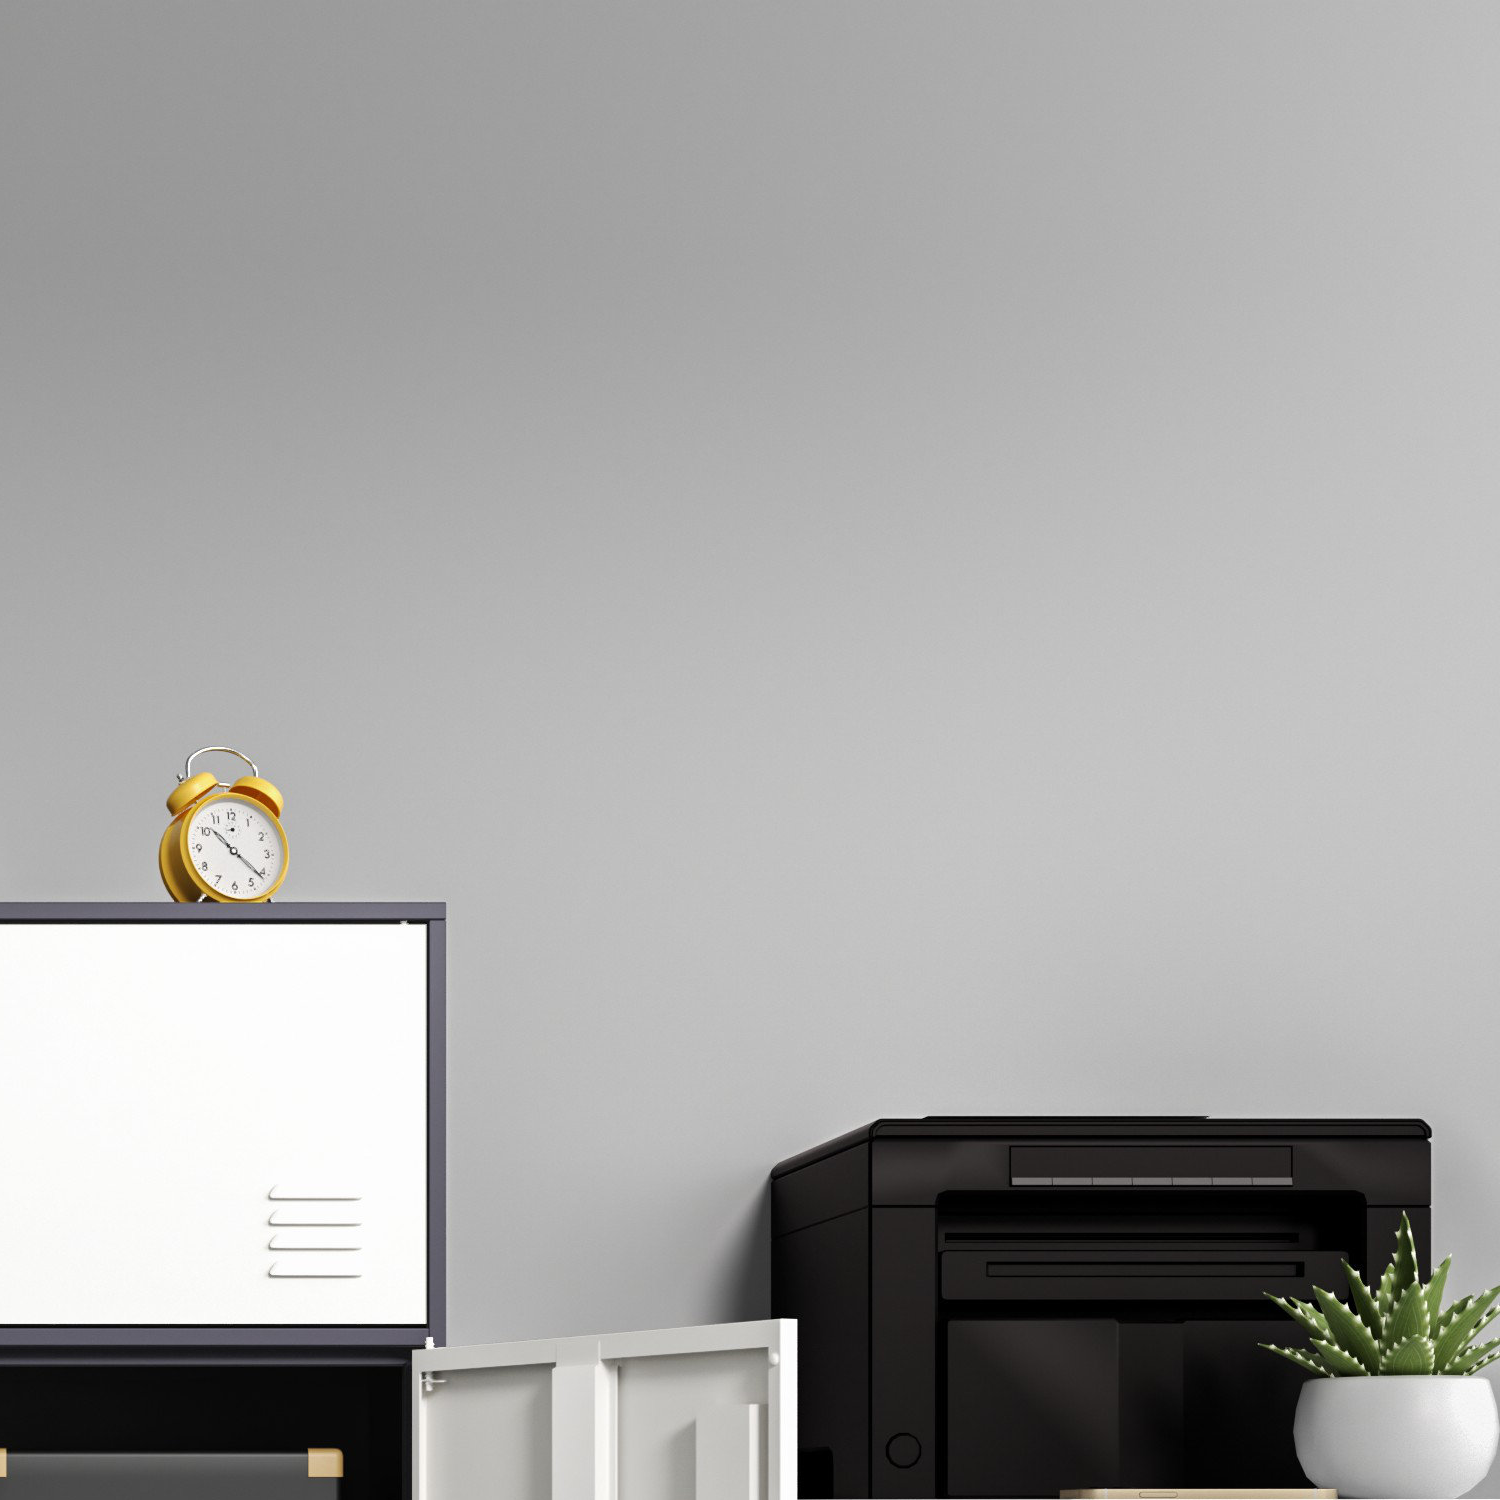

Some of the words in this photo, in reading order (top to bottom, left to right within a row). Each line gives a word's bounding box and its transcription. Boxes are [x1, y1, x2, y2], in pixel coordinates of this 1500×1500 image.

[212, 814, 220, 824] 11
[226, 811, 236, 821] 12
[201, 826, 211, 836] 10
[258, 832, 264, 841] 2
[196, 843, 202, 853] 9
[264, 849, 270, 859] 3
[201, 861, 208, 871] 8
[215, 874, 222, 884] 7
[248, 877, 255, 887] 5
[231, 881, 238, 891] 6
